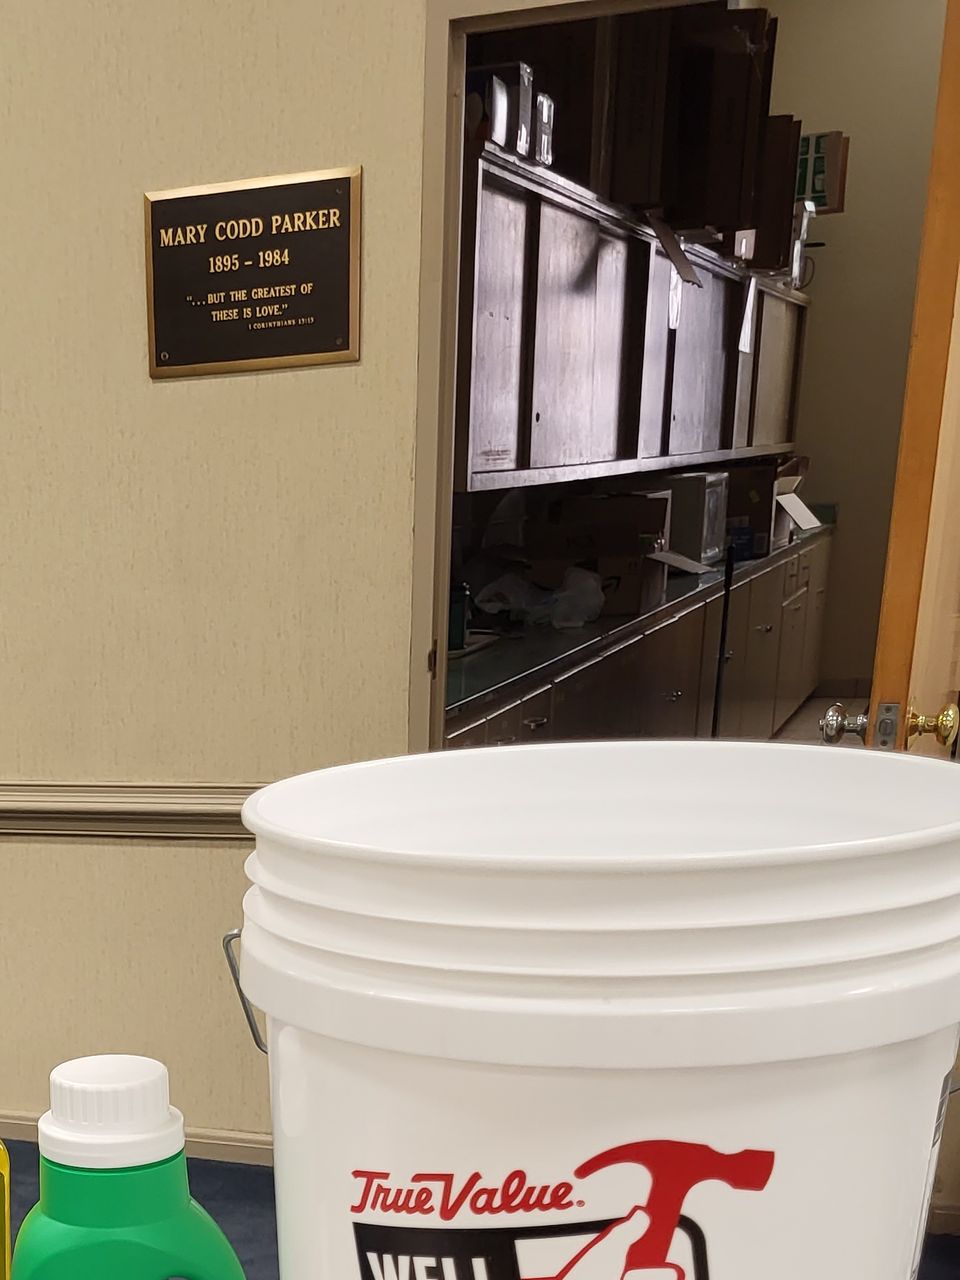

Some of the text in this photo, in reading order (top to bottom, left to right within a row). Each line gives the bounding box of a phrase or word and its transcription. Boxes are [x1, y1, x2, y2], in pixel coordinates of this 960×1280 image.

[160, 208, 341, 247] MARY CODD PARKER
[208, 254, 240, 273] 1895
[258, 249, 290, 268] 1984
[230, 290, 248, 302] THE
[251, 285, 297, 300] GREATEST
[300, 283, 314, 295] OF
[211, 308, 239, 322] THESE
[243, 306, 252, 319] IS
